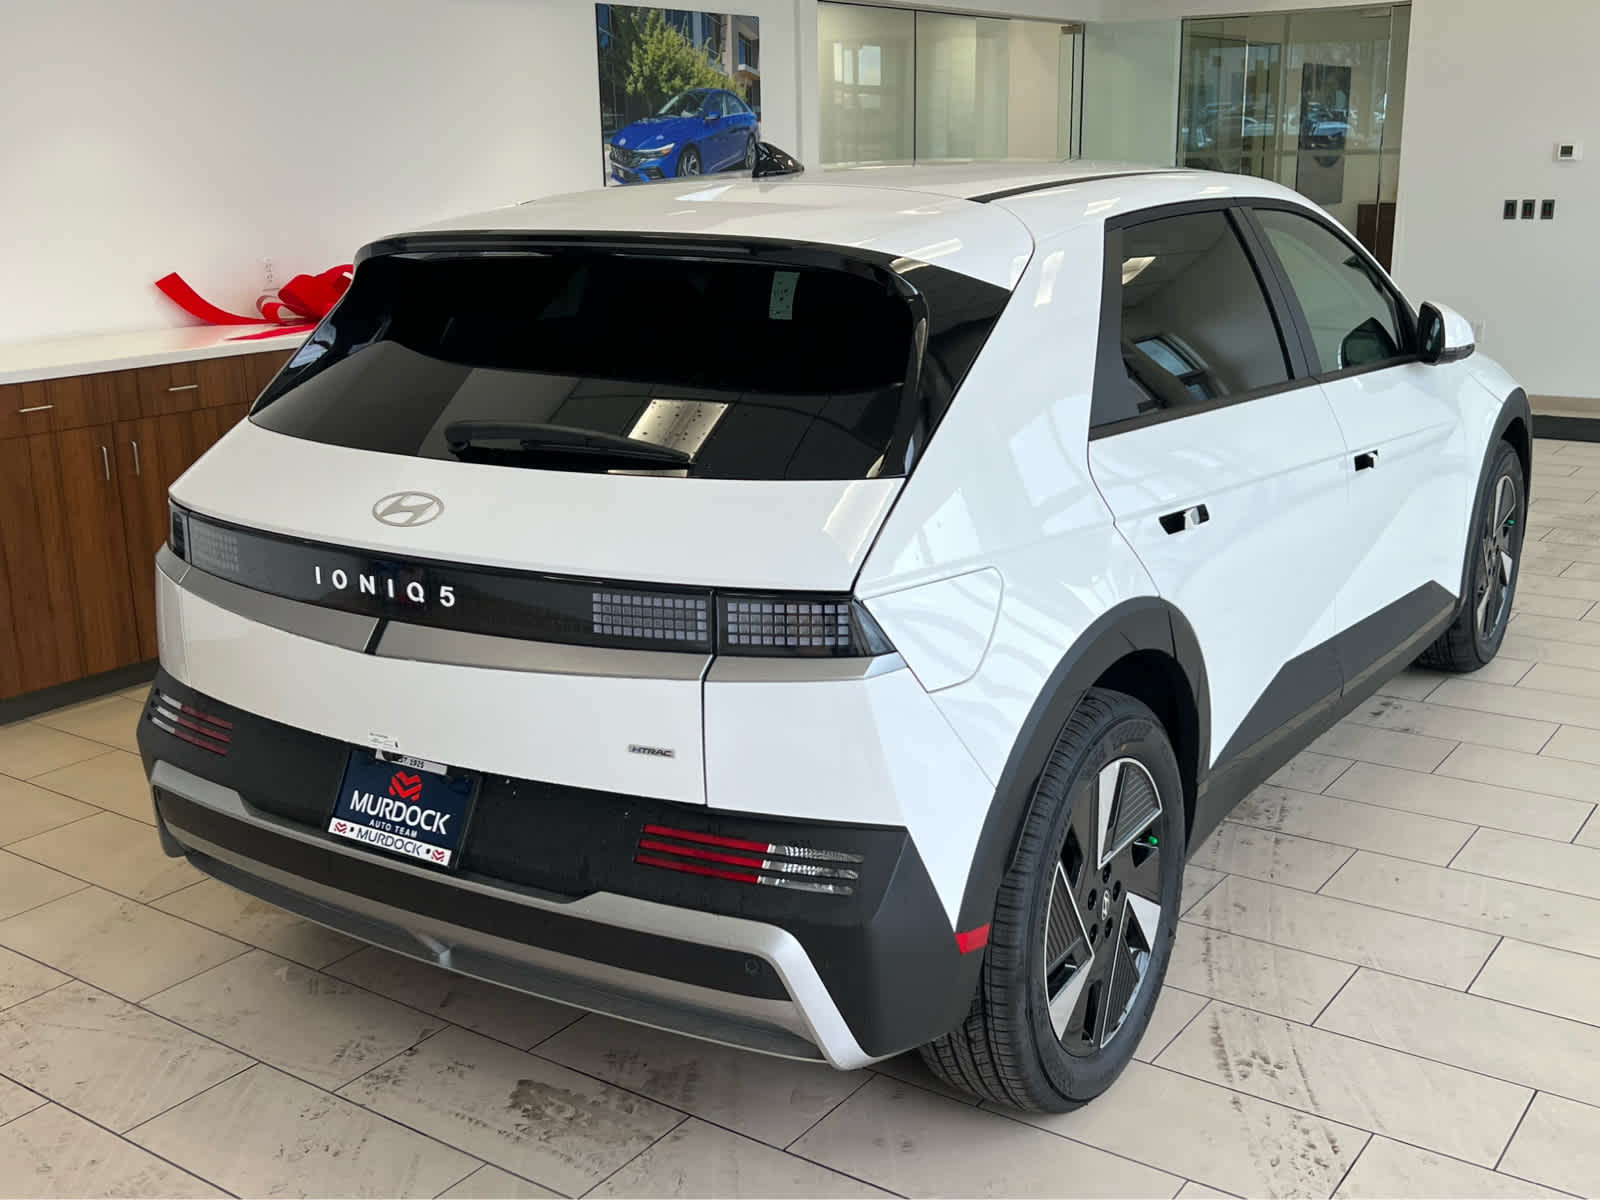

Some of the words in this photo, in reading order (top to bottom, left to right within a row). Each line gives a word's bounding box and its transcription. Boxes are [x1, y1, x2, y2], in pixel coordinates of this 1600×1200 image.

[315, 566, 424, 603] IONIQ
[440, 585, 456, 607] 5
[628, 744, 675, 759] HTRAC
[350, 790, 450, 835] MURDOCK
[356, 827, 423, 856] MURDOCK
[369, 819, 391, 832] AUTO
[395, 826, 418, 838] TEAM
